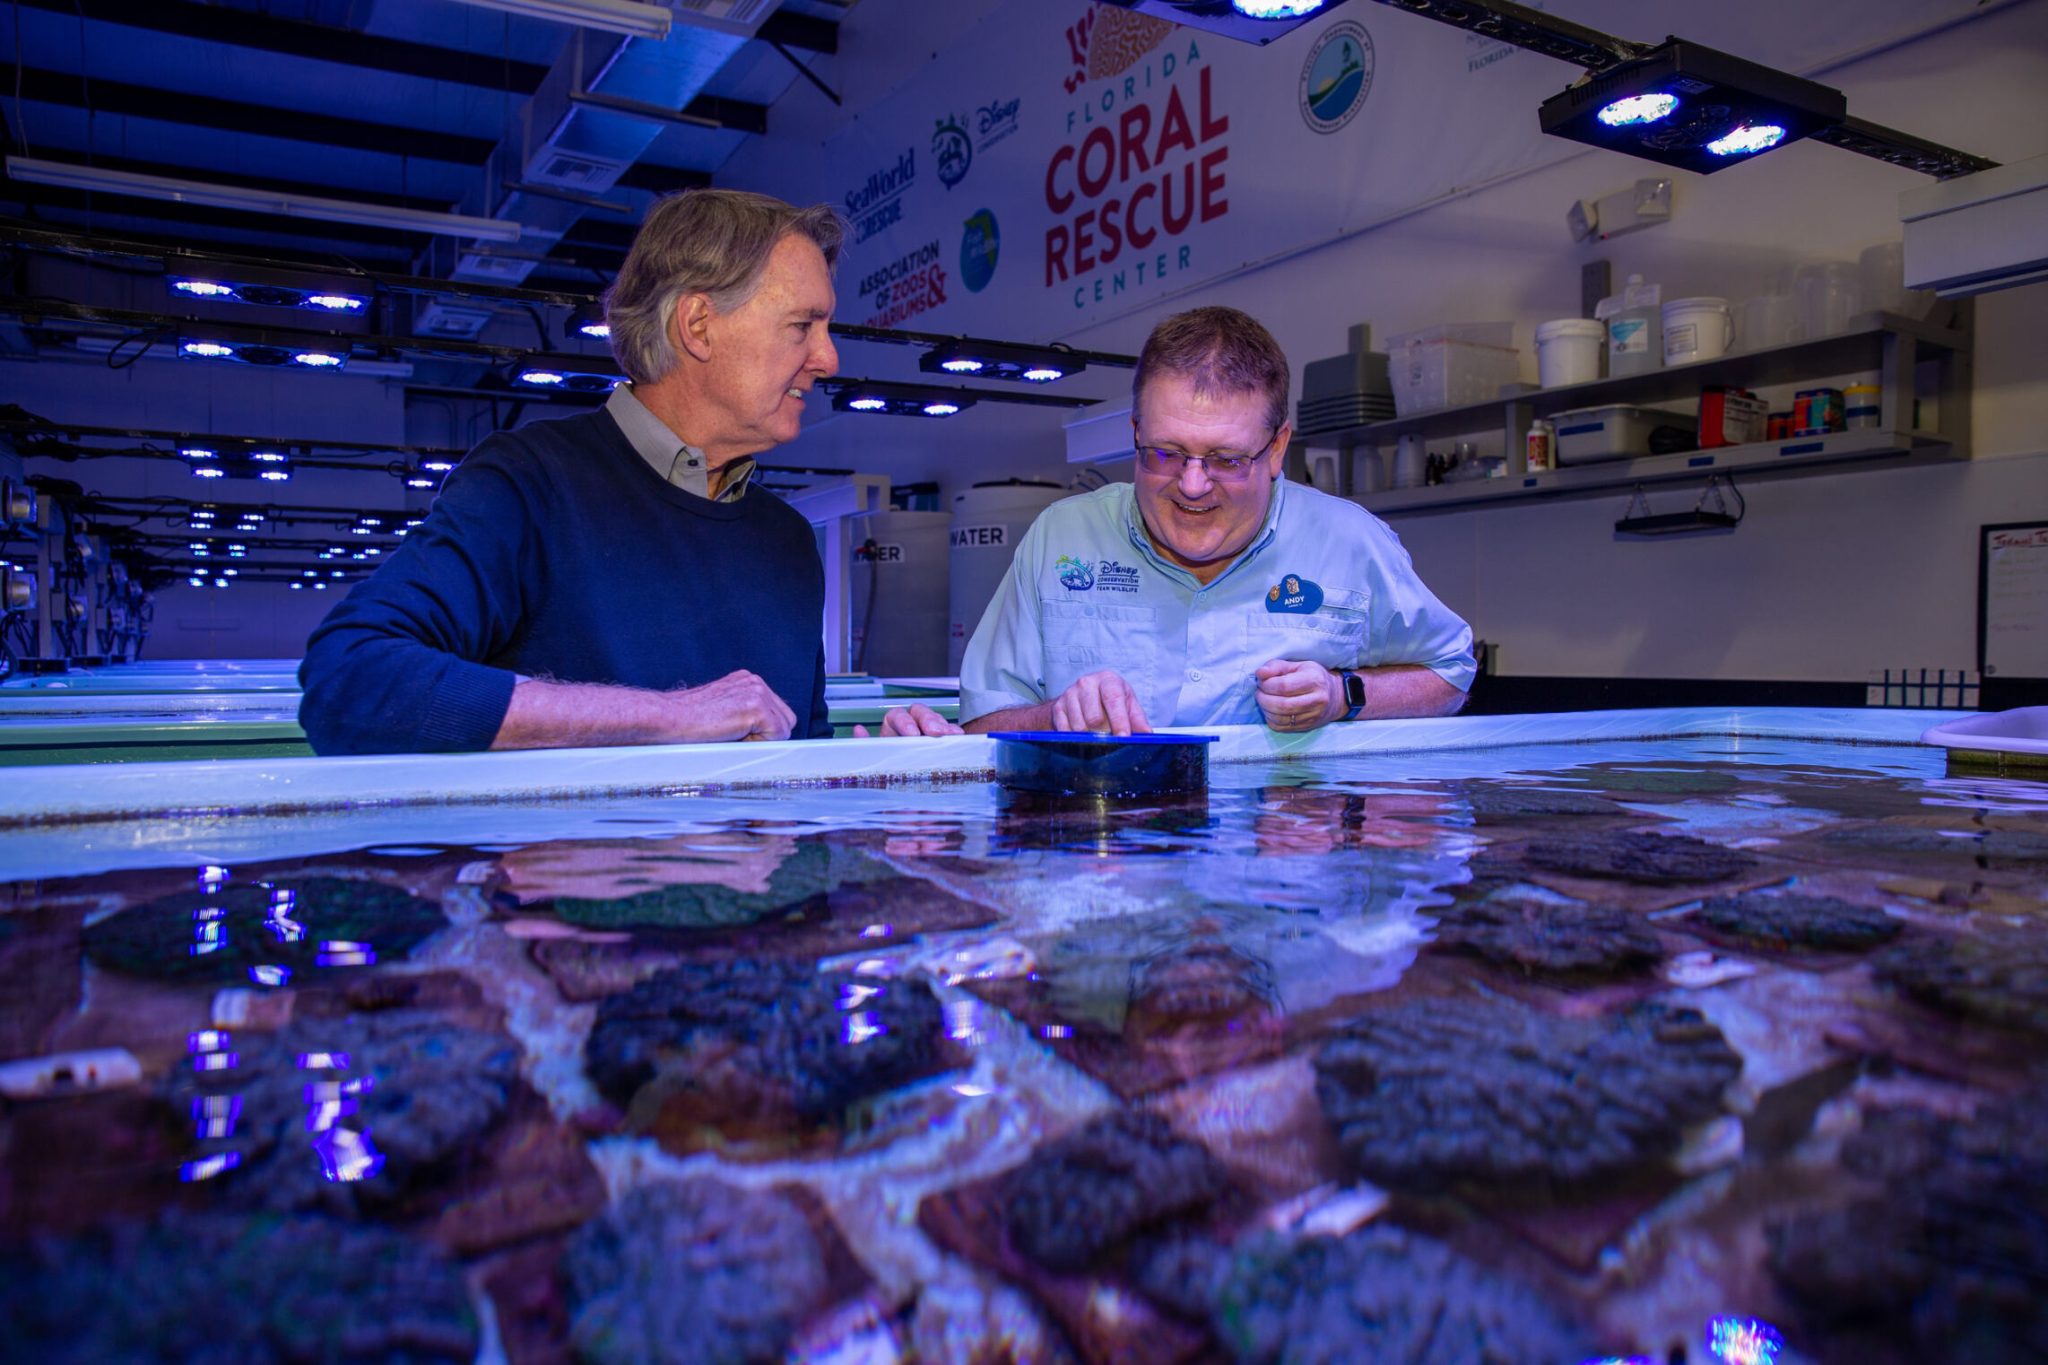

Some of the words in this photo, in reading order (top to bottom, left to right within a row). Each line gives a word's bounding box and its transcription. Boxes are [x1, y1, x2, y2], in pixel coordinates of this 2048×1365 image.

[1067, 39, 1200, 134] FLORIDA
[1045, 64, 1229, 215] CORAL
[845, 147, 915, 218] SeaWorld
[1045, 146, 1229, 288] RESCUE
[859, 238, 940, 298] ASSOCIATION
[875, 286, 891, 310] OF
[891, 269, 927, 302] ZOOS
[927, 263, 948, 308] &
[1074, 245, 1191, 309] CENTER
[951, 527, 1003, 546] WATER
[1099, 560, 1138, 579] Disney
[1284, 595, 1305, 605] ANDY
